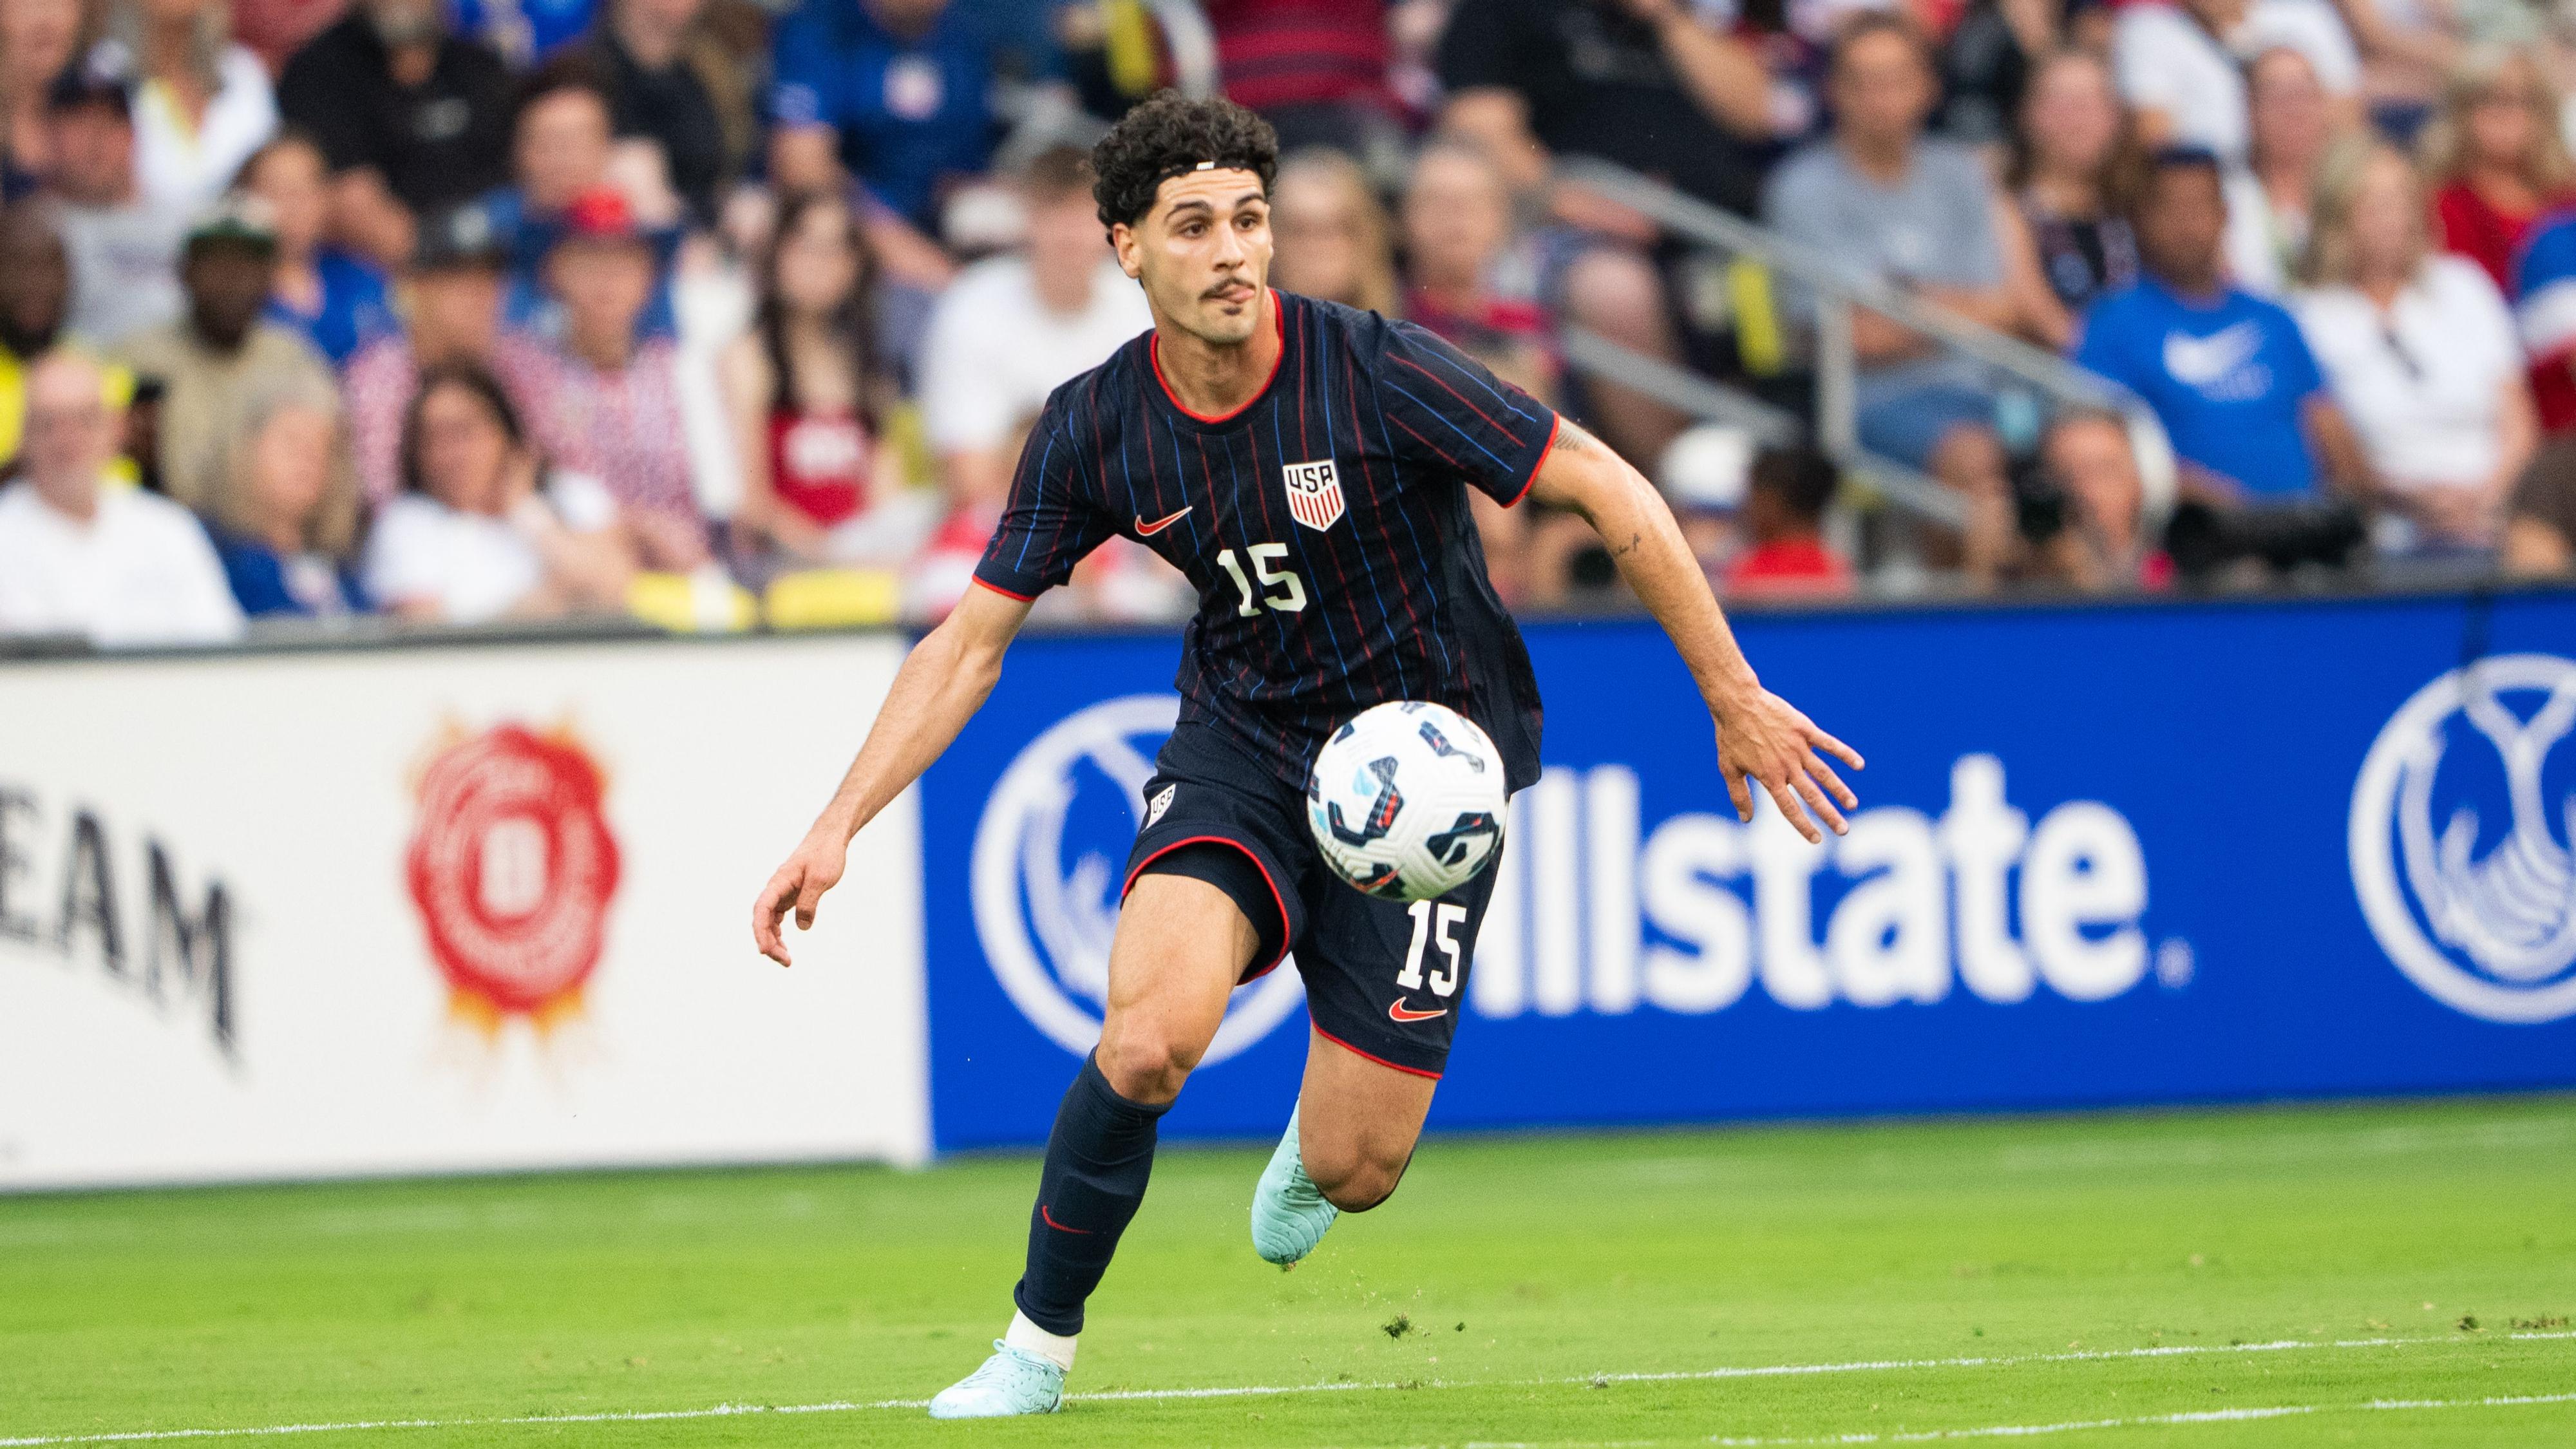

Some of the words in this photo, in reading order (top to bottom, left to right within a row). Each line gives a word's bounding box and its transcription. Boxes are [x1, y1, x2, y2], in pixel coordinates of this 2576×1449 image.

[1288, 464, 1334, 493] USA
[1217, 542, 1307, 617] 15
[1396, 898, 1467, 997] 15
